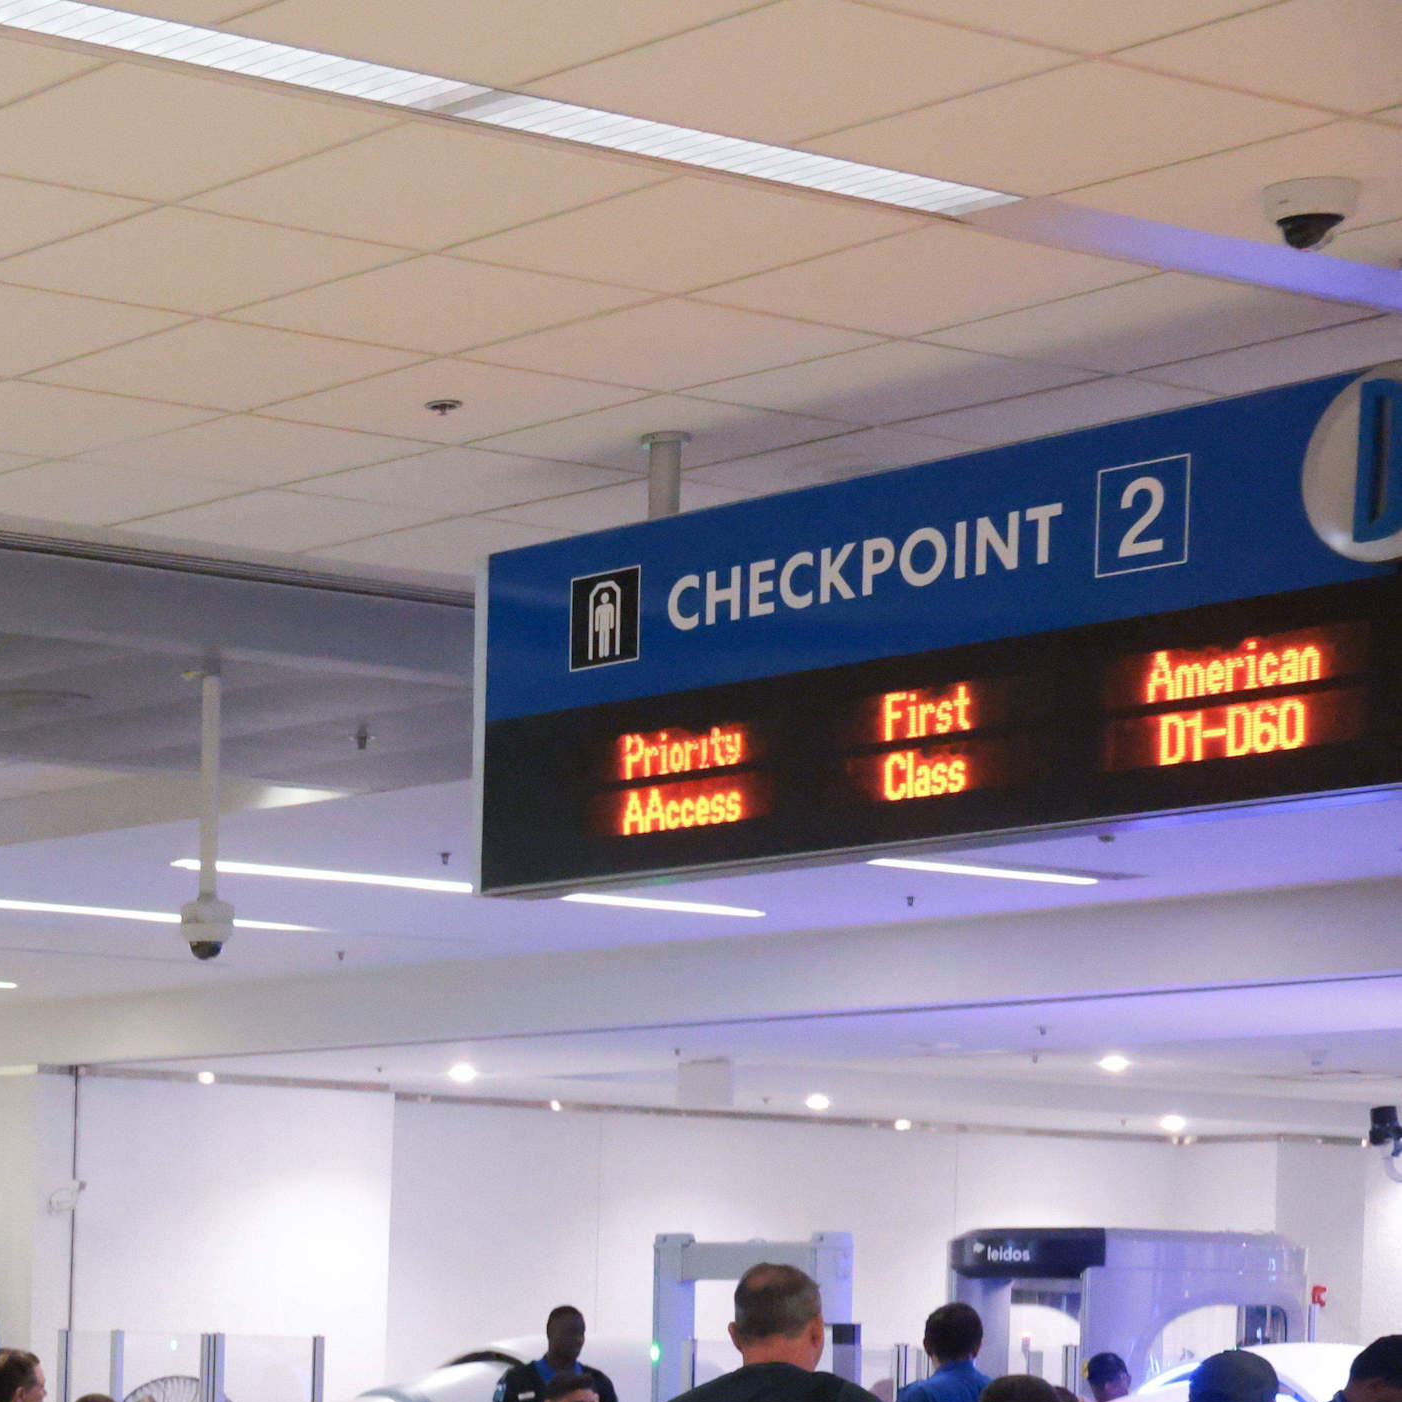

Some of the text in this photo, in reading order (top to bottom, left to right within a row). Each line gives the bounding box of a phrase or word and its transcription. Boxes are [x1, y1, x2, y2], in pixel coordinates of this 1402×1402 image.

[667, 475, 1166, 631] CHECKPOINT 2
[1146, 642, 1321, 705] American
[883, 686, 973, 742] First
[1157, 698, 1306, 767] D1-D60
[883, 752, 967, 802] Class
[987, 1245, 1030, 1262] leidos
